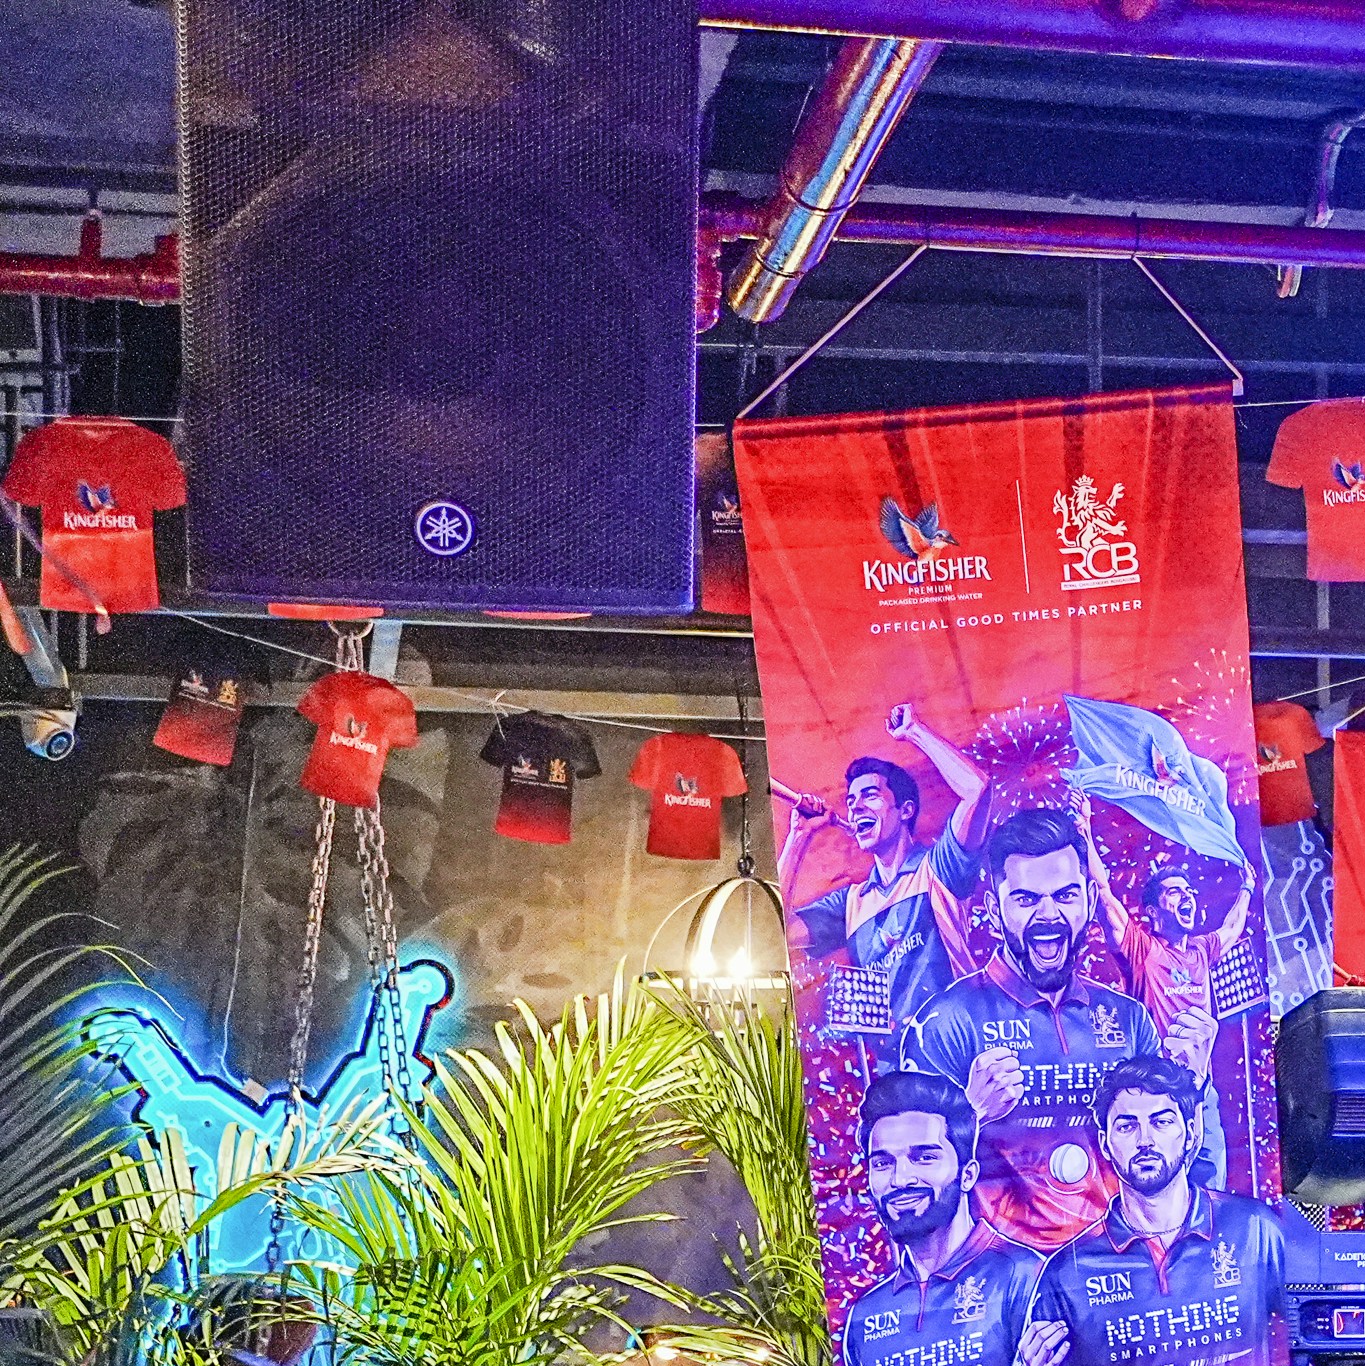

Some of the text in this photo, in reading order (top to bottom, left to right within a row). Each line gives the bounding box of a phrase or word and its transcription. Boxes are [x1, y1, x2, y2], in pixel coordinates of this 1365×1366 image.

[63, 511, 138, 530] KINGFISHER
[862, 555, 992, 592] KINGFISHER
[1058, 541, 1140, 581] RCB
[879, 592, 983, 607] PACKAGED DRINKING WATER
[908, 584, 953, 596] PREMIUM
[870, 599, 1143, 635] OFFICIAL GOOD TIMES PARTNER
[1115, 765, 1206, 817] KINGFISHER
[982, 1018, 1032, 1042] SUN
[1086, 1271, 1132, 1297] SUN
[1088, 1289, 1135, 1307] PHARMA
[864, 1309, 902, 1334] SUN
[1105, 1295, 1240, 1348] NOTHING
[863, 1327, 901, 1343] PHARMA
[1109, 1328, 1243, 1362] SMARTPHONES
